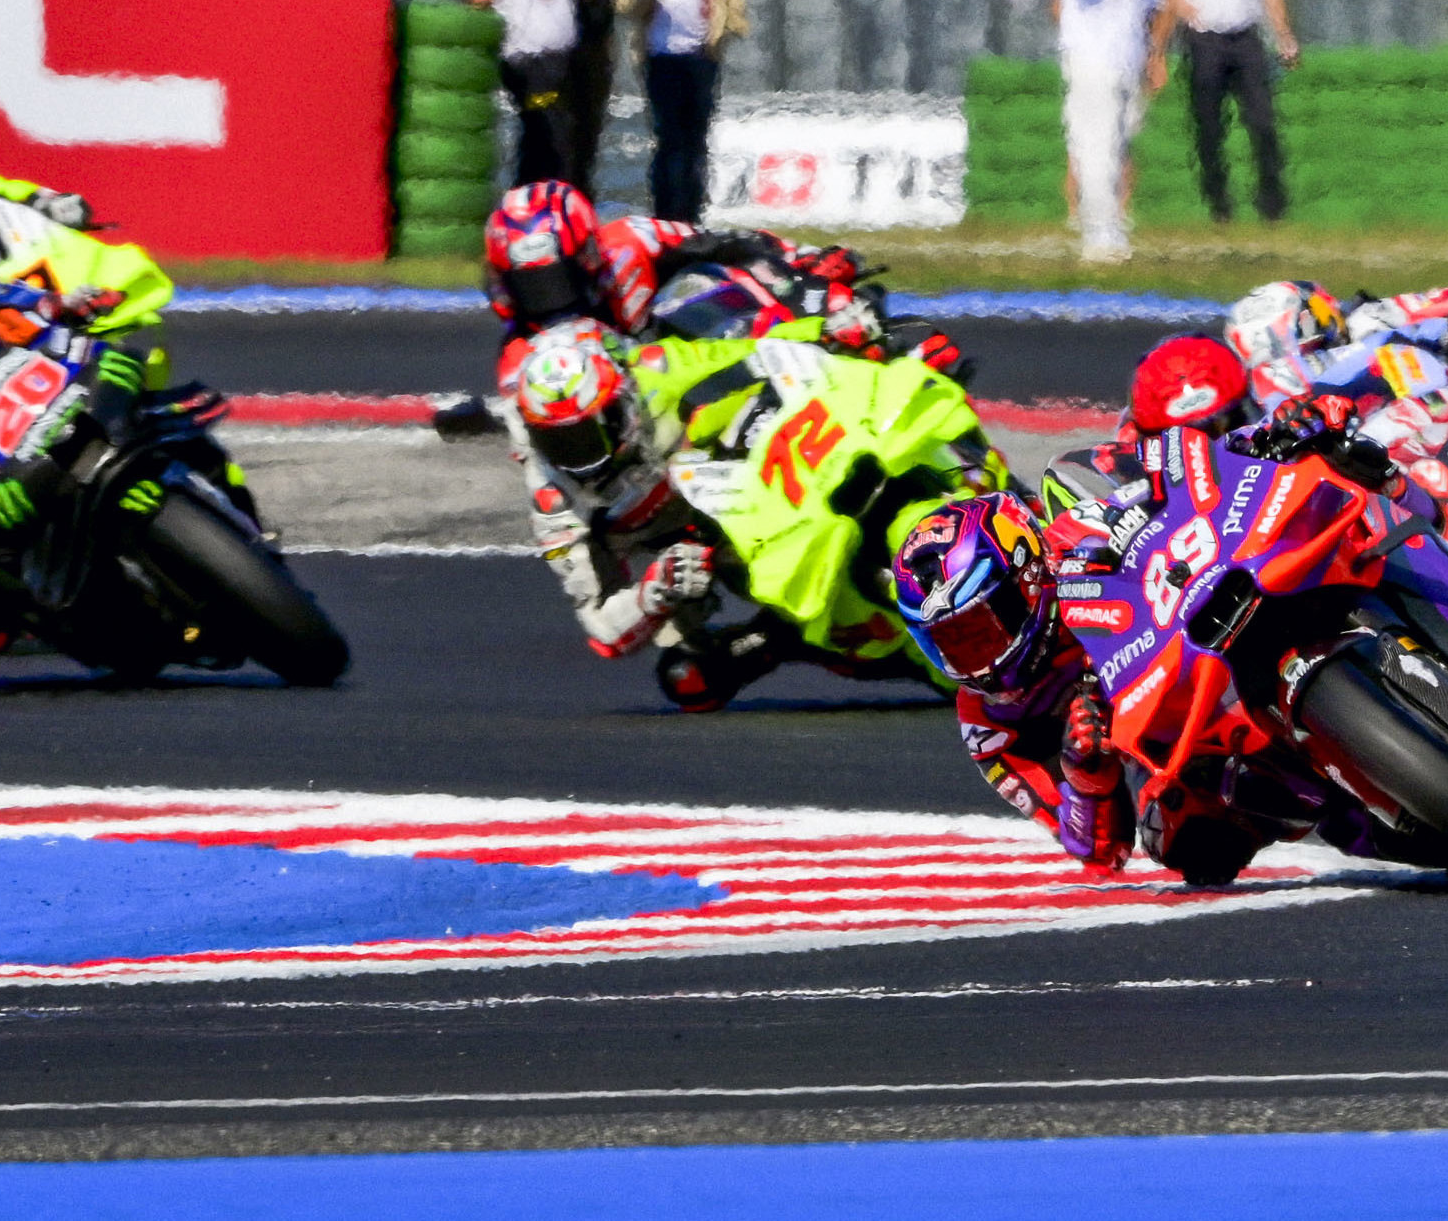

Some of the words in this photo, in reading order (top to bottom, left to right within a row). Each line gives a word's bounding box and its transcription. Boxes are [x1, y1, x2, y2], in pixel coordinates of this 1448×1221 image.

[759, 398, 847, 508] 72
[1107, 504, 1151, 556] FIAMM
[1222, 464, 1263, 537] prima
[1256, 472, 1296, 535] MOTUL
[1122, 520, 1165, 571] prima
[1143, 516, 1219, 629] 89
[1065, 607, 1122, 626] PRAMAC
[1099, 627, 1157, 691] prima
